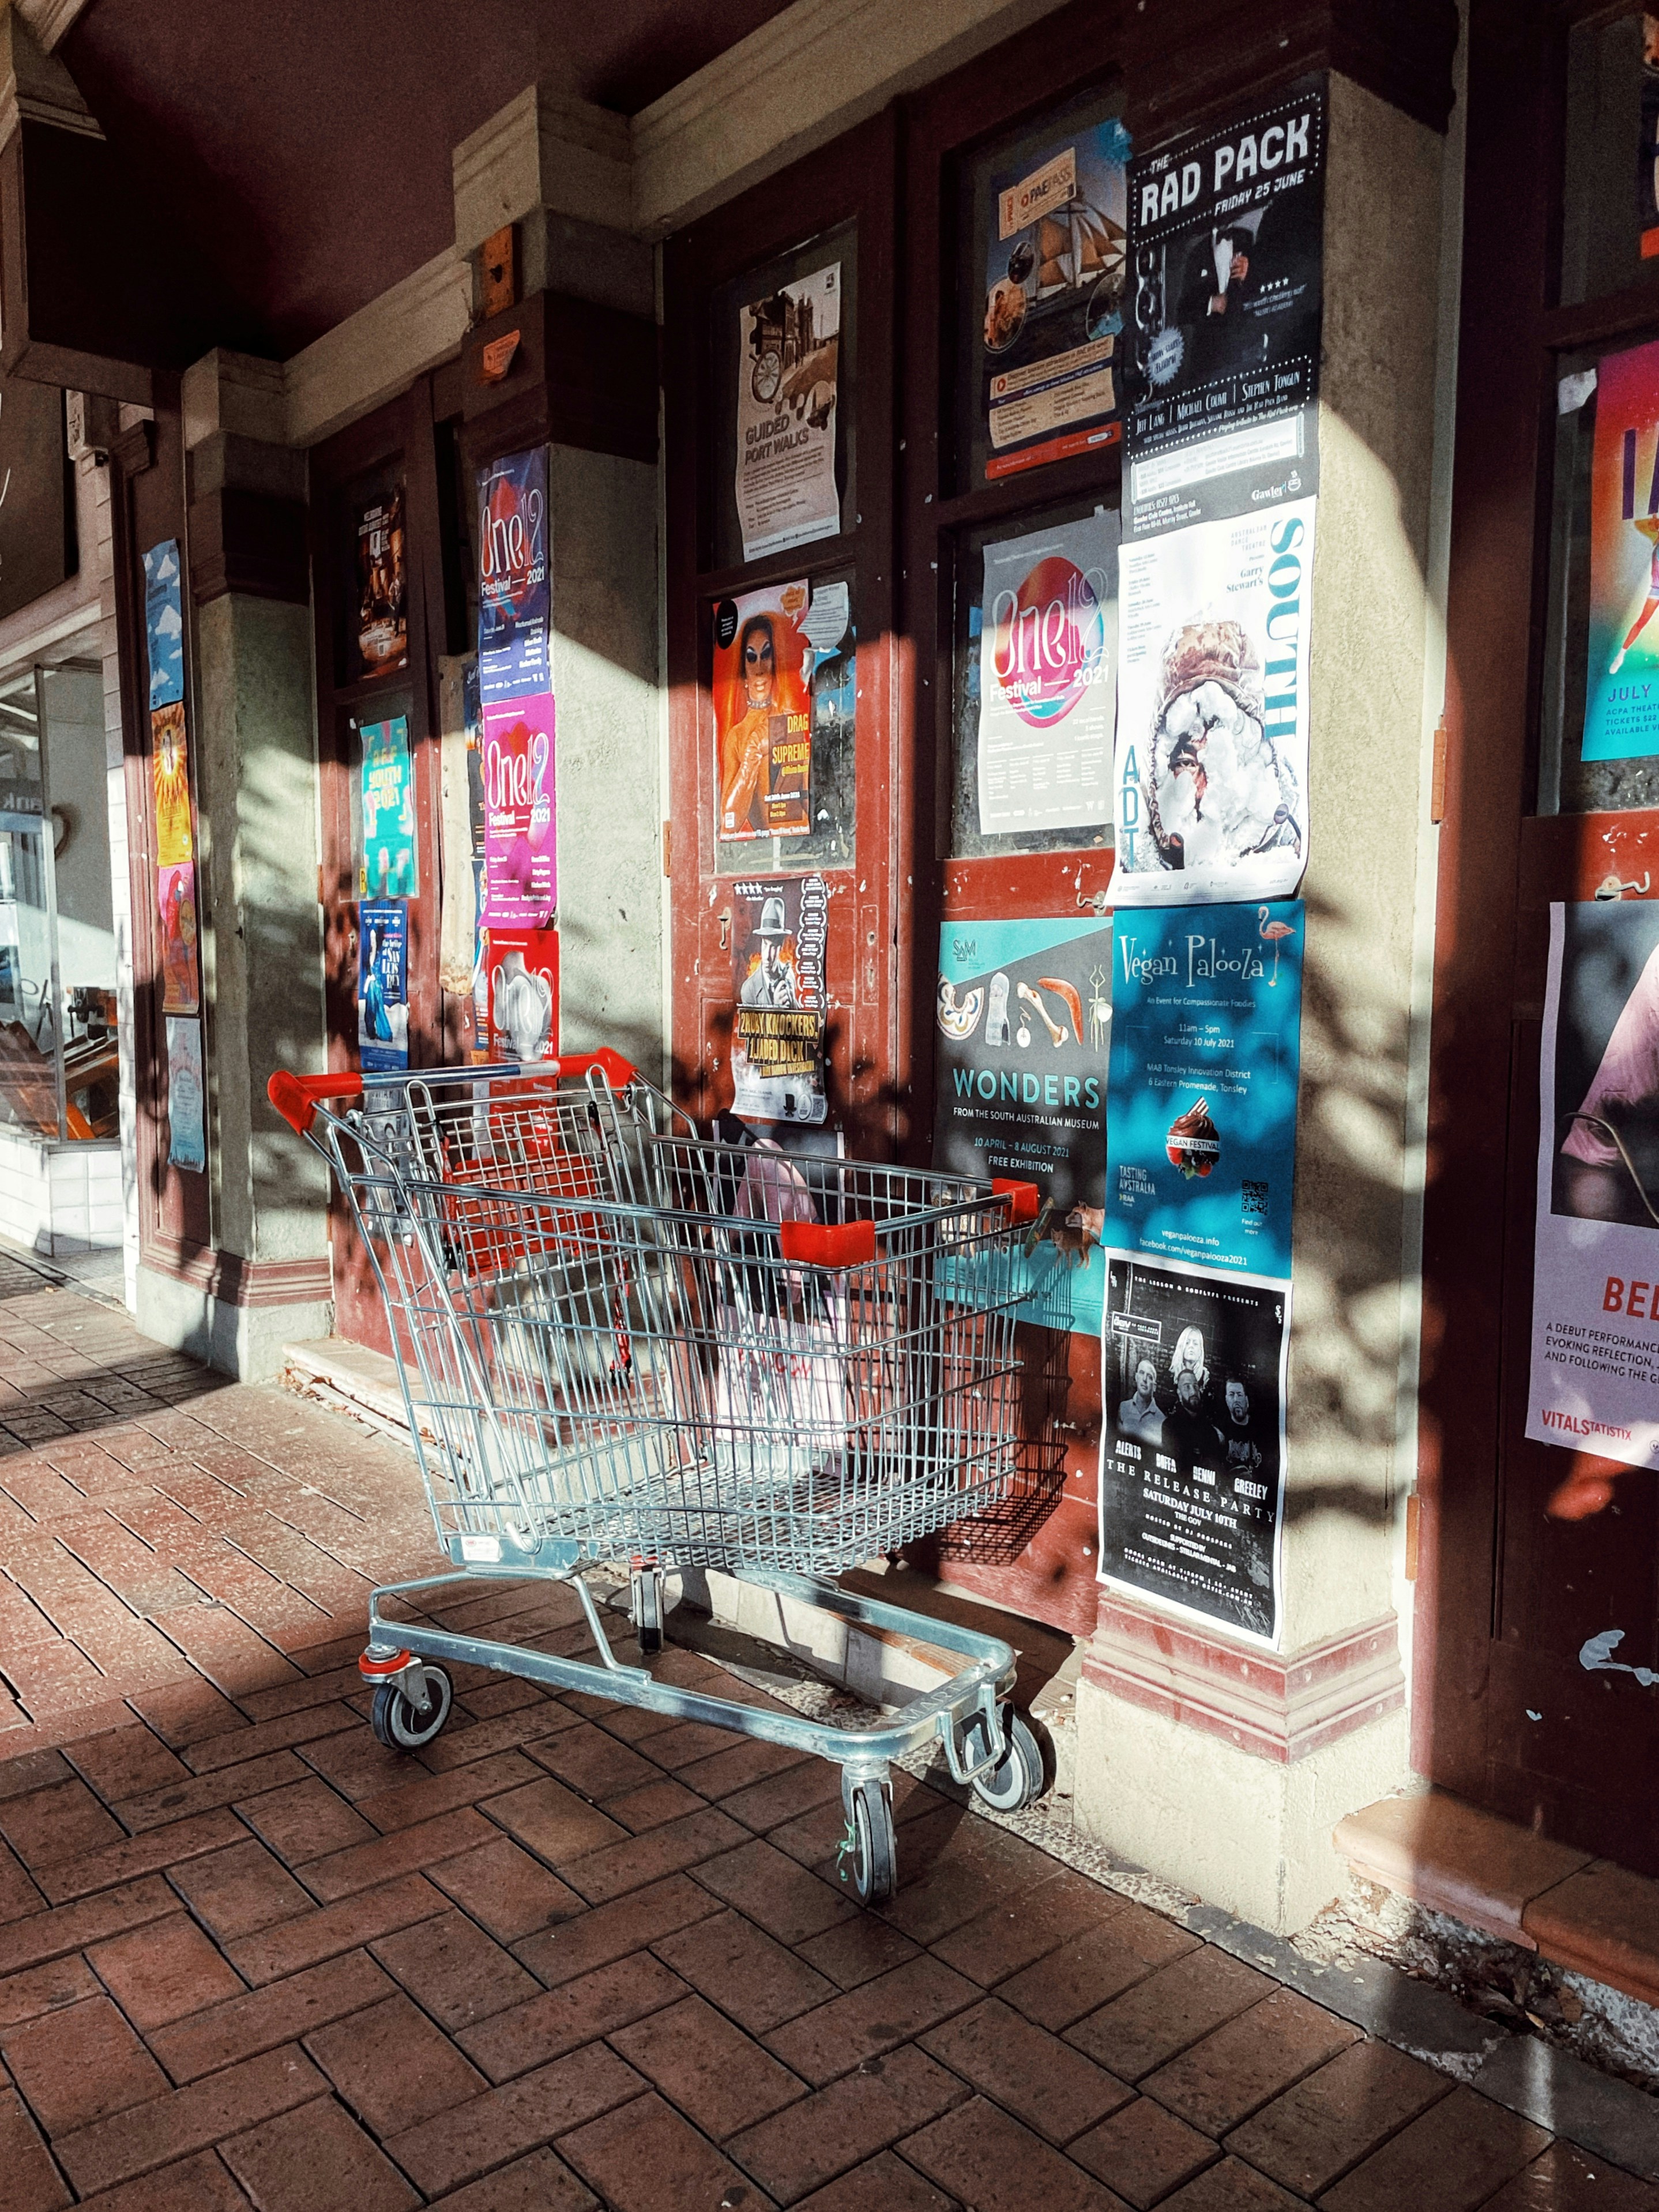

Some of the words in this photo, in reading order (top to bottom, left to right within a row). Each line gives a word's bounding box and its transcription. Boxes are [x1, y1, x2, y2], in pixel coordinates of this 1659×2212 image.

[1141, 162, 1201, 226] RAD
[1214, 114, 1310, 191] PACK
[1150, 154, 1169, 174] THE
[1214, 189, 1252, 216] FRIDAY
[1255, 182, 1270, 200] 25
[1274, 169, 1306, 192] JUNE
[746, 413, 790, 445] GUIDED
[744, 441, 773, 465] PORT
[773, 427, 810, 455] WALKS
[1251, 486, 1282, 501] Gawler
[481, 575, 511, 596] Festival
[526, 566, 545, 585] 2021
[1240, 566, 1264, 580] Garry
[1226, 577, 1263, 593] Stewart's
[1264, 517, 1305, 739] SOUTH
[990, 676, 1041, 702] Festival
[1073, 665, 1109, 688] 2021
[1608, 684, 1652, 702] JULY
[1605, 716, 1641, 725] TICKETS
[1606, 708, 1628, 716] ACPA
[787, 714, 808, 733] DRAG
[1605, 725, 1649, 735] AVAILABLE
[772, 743, 810, 765] SUPREME
[368, 765, 402, 790] YOUTH
[373, 786, 400, 810] 2021
[1122, 745, 1139, 868] ADT
[488, 810, 516, 827] Festival
[531, 807, 551, 823] 2021
[1119, 935, 1178, 985] Vegan
[1156, 997, 1172, 1005] Event
[1173, 997, 1182, 1005] for
[1183, 998, 1229, 1007] Compassionate
[1179, 1024, 1198, 1032] 11am
[1205, 1025, 1220, 1034] 5pm
[493, 1032, 519, 1049] Festival
[535, 1040, 554, 1055] 2021
[780, 1039, 804, 1062] DICK
[1164, 1036, 1192, 1047] Saturday
[1194, 1037, 1202, 1046] 10
[1203, 1037, 1217, 1048] July
[1217, 1039, 1235, 1048] 2021
[1164, 1064, 1187, 1075] Tonsley
[1188, 1067, 1223, 1077] Innovation
[1225, 1069, 1251, 1079] District
[953, 1068, 1100, 1109] WONDERS
[1154, 1078, 1177, 1088] Eastern
[1178, 1080, 1219, 1092] Promenade,
[1220, 1083, 1247, 1095] Tonsley
[953, 1107, 974, 1118] FROM
[975, 1109, 989, 1119] THE
[990, 1111, 1015, 1122] SOUTH
[1016, 1113, 1063, 1126] AUSTRALIAN
[1064, 1119, 1099, 1130] MUSEUM
[974, 1137, 983, 1146] 10
[984, 1138, 1007, 1149] APRIL
[1014, 1142, 1019, 1151] 8
[1020, 1142, 1051, 1155] AUGUST
[1052, 1146, 1069, 1158] 2021
[1165, 1136, 1188, 1146] VEGAN
[1190, 1140, 1220, 1151] FESTIVAL
[988, 1156, 1008, 1167] FREE
[1010, 1158, 1054, 1173] EXHIBITION
[1119, 1165, 1147, 1181] TASTING
[1161, 1229, 1220, 1247] veganpalooza.info
[1139, 1237, 1248, 1266] facebook.com/veganpalooza2021
[1545, 1322, 1553, 1331] A
[1555, 1323, 1587, 1337] DEBUT
[1545, 1336, 1590, 1353] EVOKING
[1592, 1345, 1654, 1370] REFLECTION,
[1544, 1350, 1567, 1363] AND
[1568, 1355, 1626, 1376] FOLLOWING
[1628, 1368, 1647, 1382] THE
[1541, 1409, 1631, 1440] VITALSTATISTIX
[1115, 1440, 1142, 1461] ALERTS
[1107, 1458, 1135, 1477] THE
[1143, 1470, 1211, 1503] RELEASE
[1220, 1496, 1275, 1523] PARTY
[1234, 1477, 1268, 1500] GREELEY
[1143, 1488, 1190, 1512] SATURDAY
[1190, 1505, 1213, 1521] JULY
[1214, 1513, 1237, 1529] 10TH
[1174, 1511, 1187, 1521] THE
[1188, 1515, 1202, 1526] GOV
[1169, 1533, 1199, 1550] SUPPORTED
[1199, 1543, 1206, 1553] BY
[1124, 1553, 1150, 1567] TICKETS
[1152, 1564, 1188, 1582] AVAILABLE
[1124, 1547, 1145, 1559] DOORS
[1148, 1556, 1165, 1567] OPEN
[1230, 1587, 1253, 1599] EVENT
